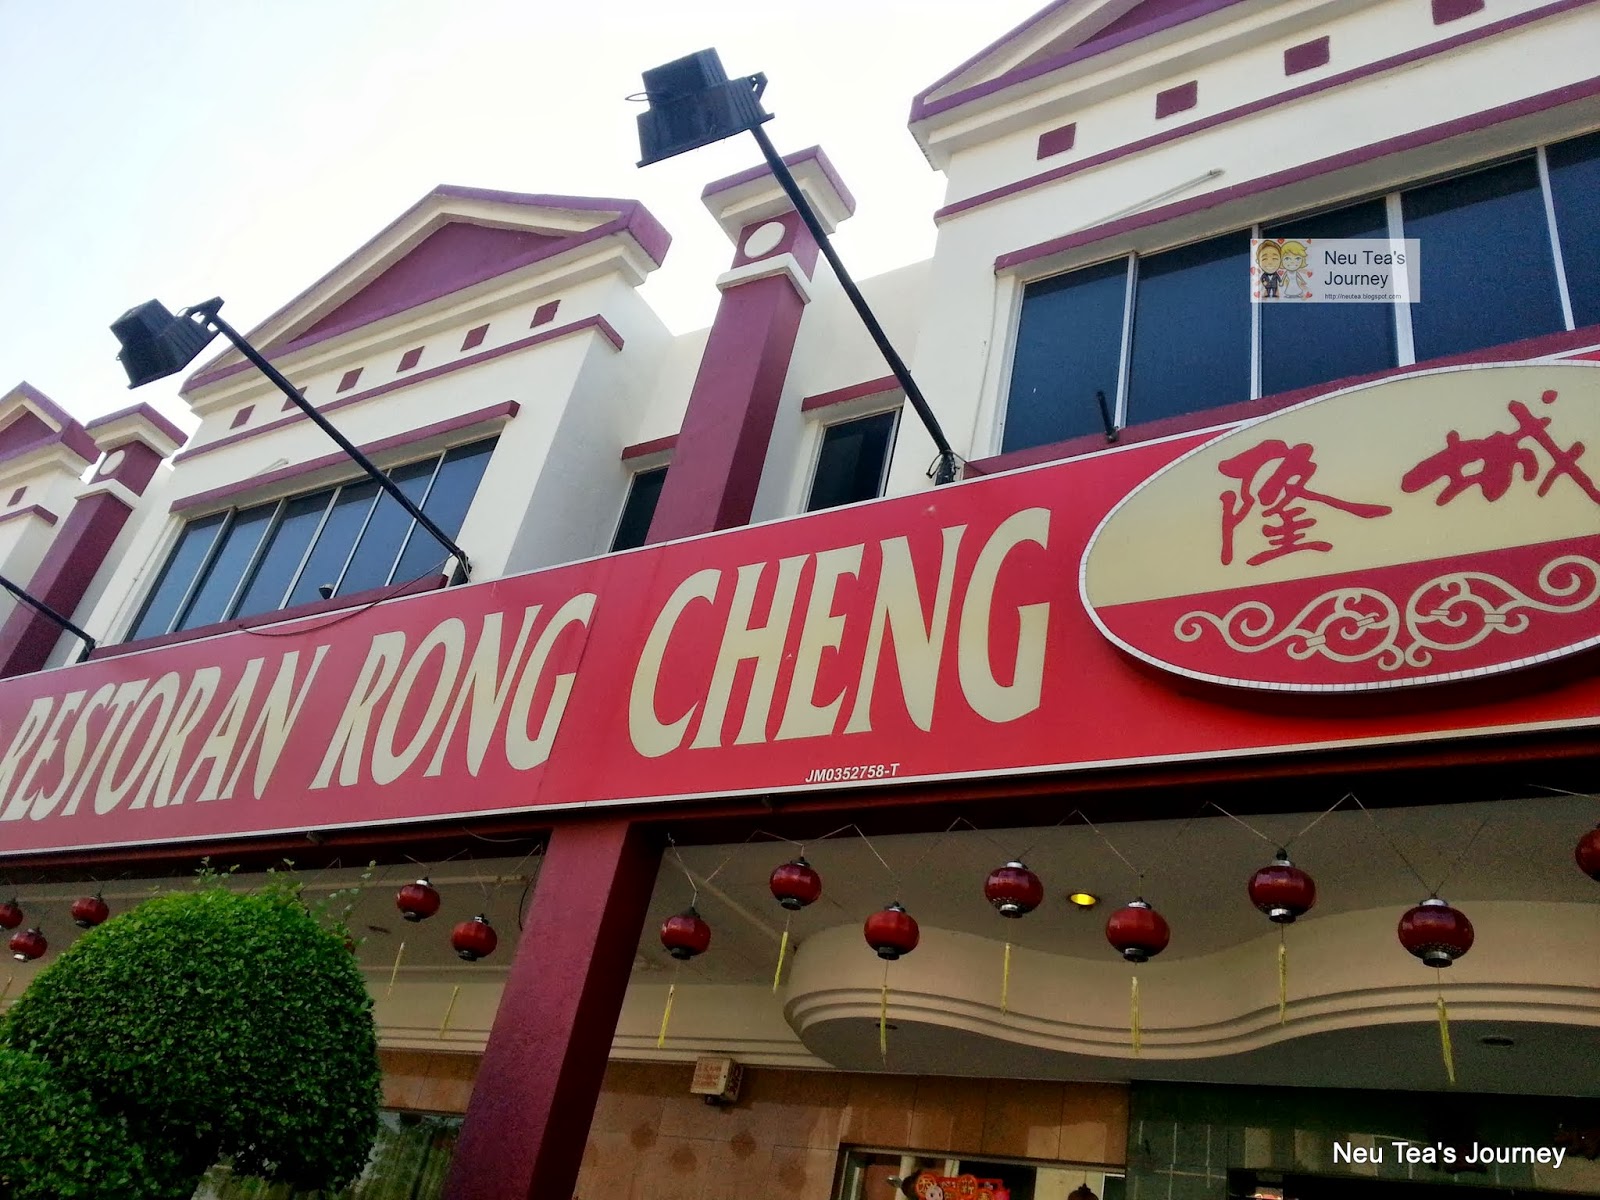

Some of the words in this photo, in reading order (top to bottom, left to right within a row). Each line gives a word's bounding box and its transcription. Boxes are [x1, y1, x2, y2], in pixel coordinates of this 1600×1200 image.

[1218, 389, 1600, 567] 隆城
[0, 644, 331, 822] RESTORAN
[308, 592, 597, 790] RONG
[628, 506, 1052, 759] CHENG
[805, 763, 900, 783] JM0352758-T
